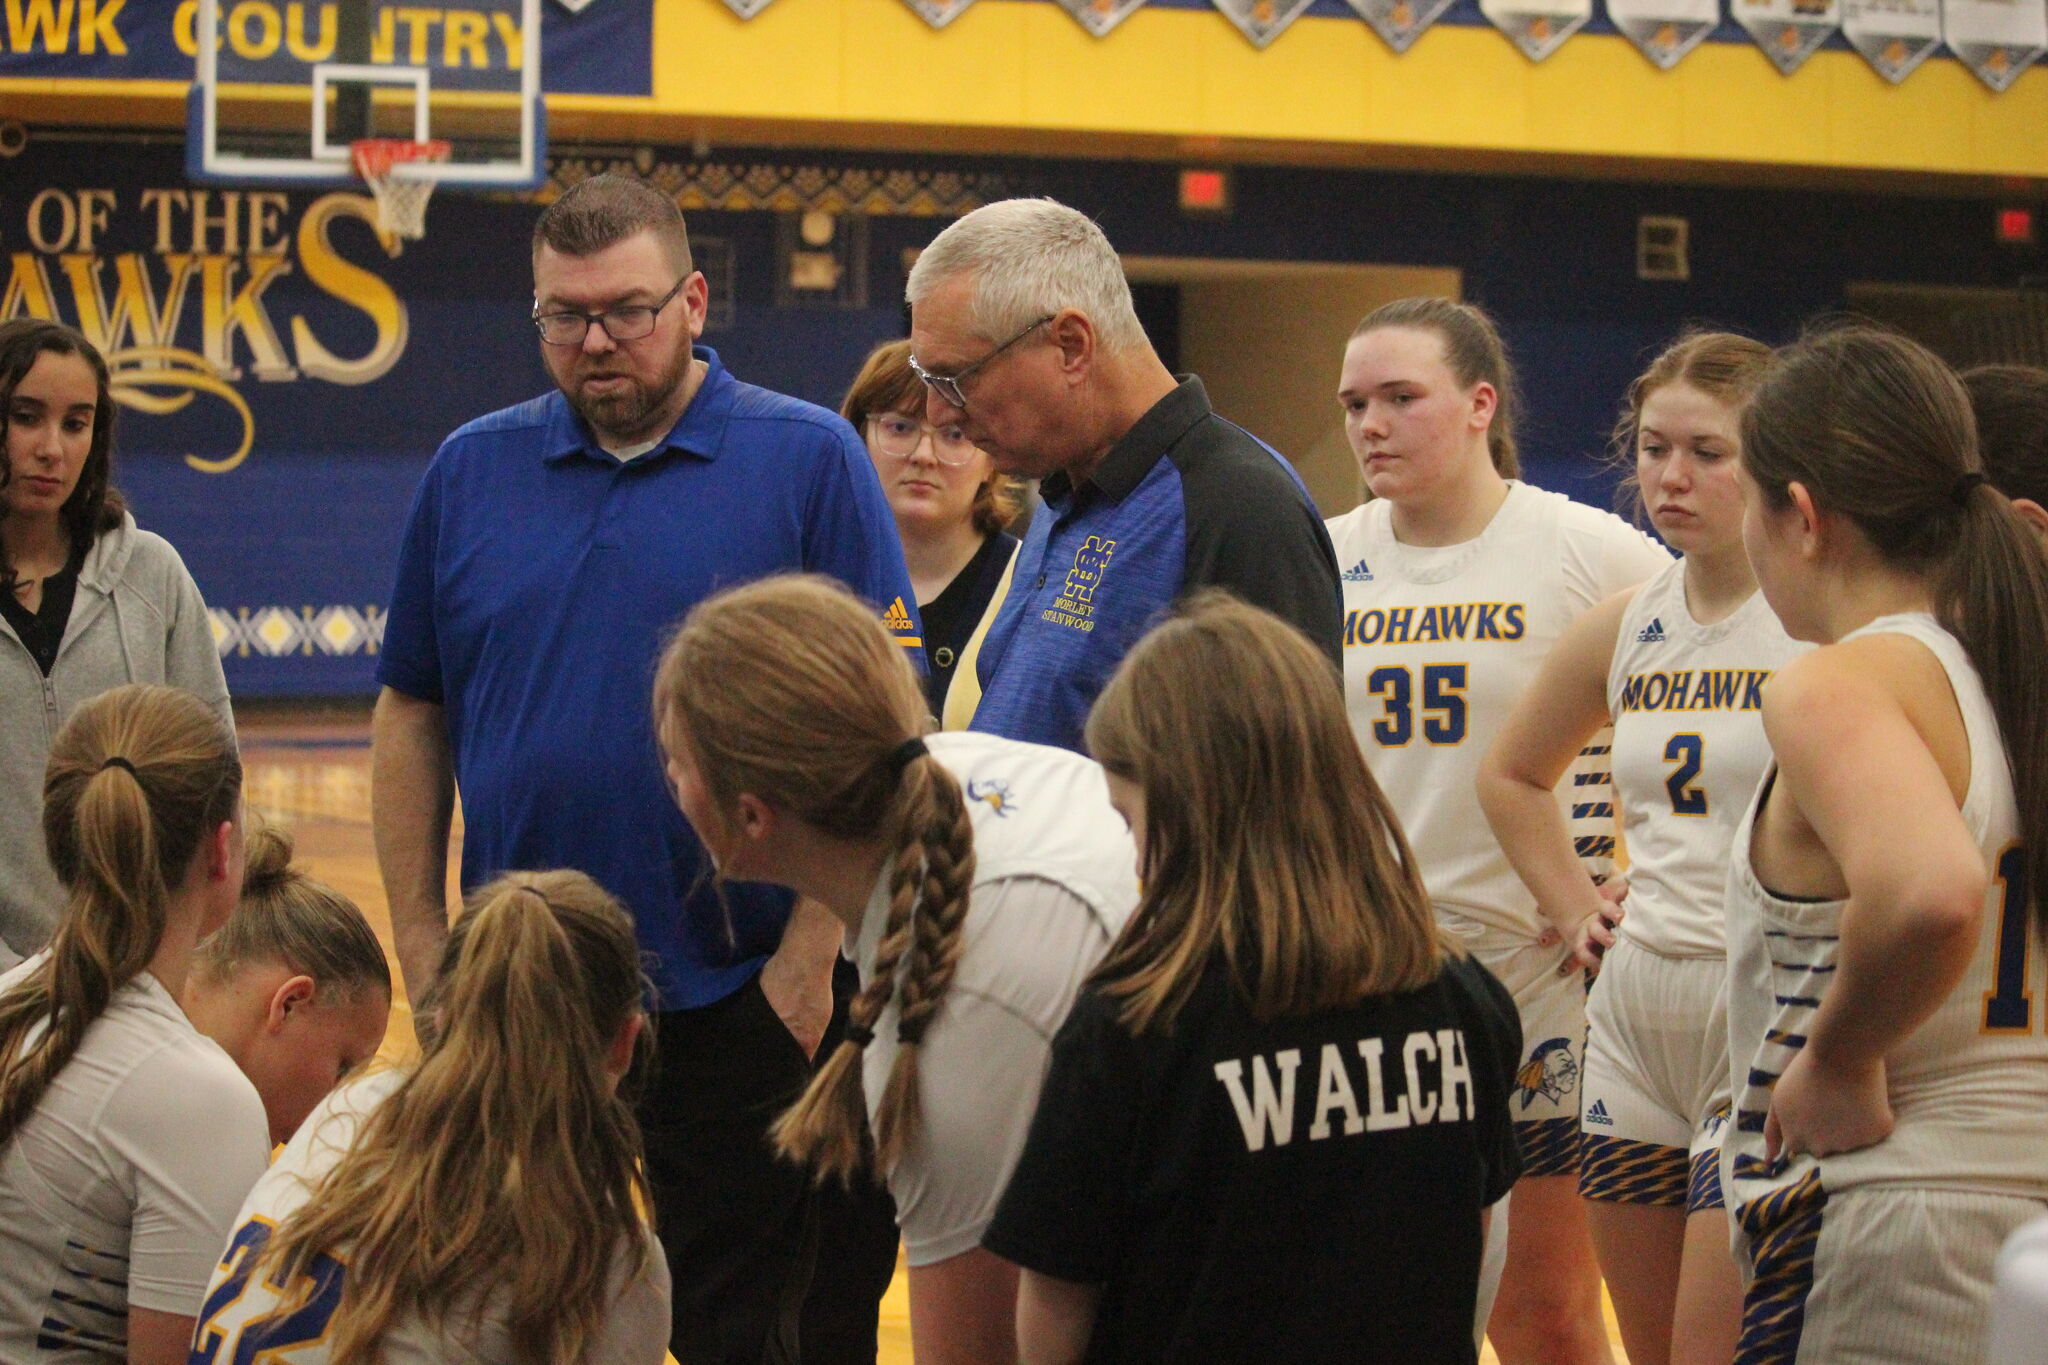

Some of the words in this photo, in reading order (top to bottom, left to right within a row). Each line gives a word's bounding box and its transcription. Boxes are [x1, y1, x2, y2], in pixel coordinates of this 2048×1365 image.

[0, 0, 129, 56] WK
[26, 188, 117, 253] OF
[140, 190, 291, 254] THE
[1041, 608, 1095, 632] STANWOOD
[1052, 596, 1095, 617] MORLEY
[1366, 662, 1469, 749] 35
[1662, 731, 1709, 818] 2
[1978, 839, 2048, 1036] 1
[1213, 1028, 1475, 1153] WALCH
